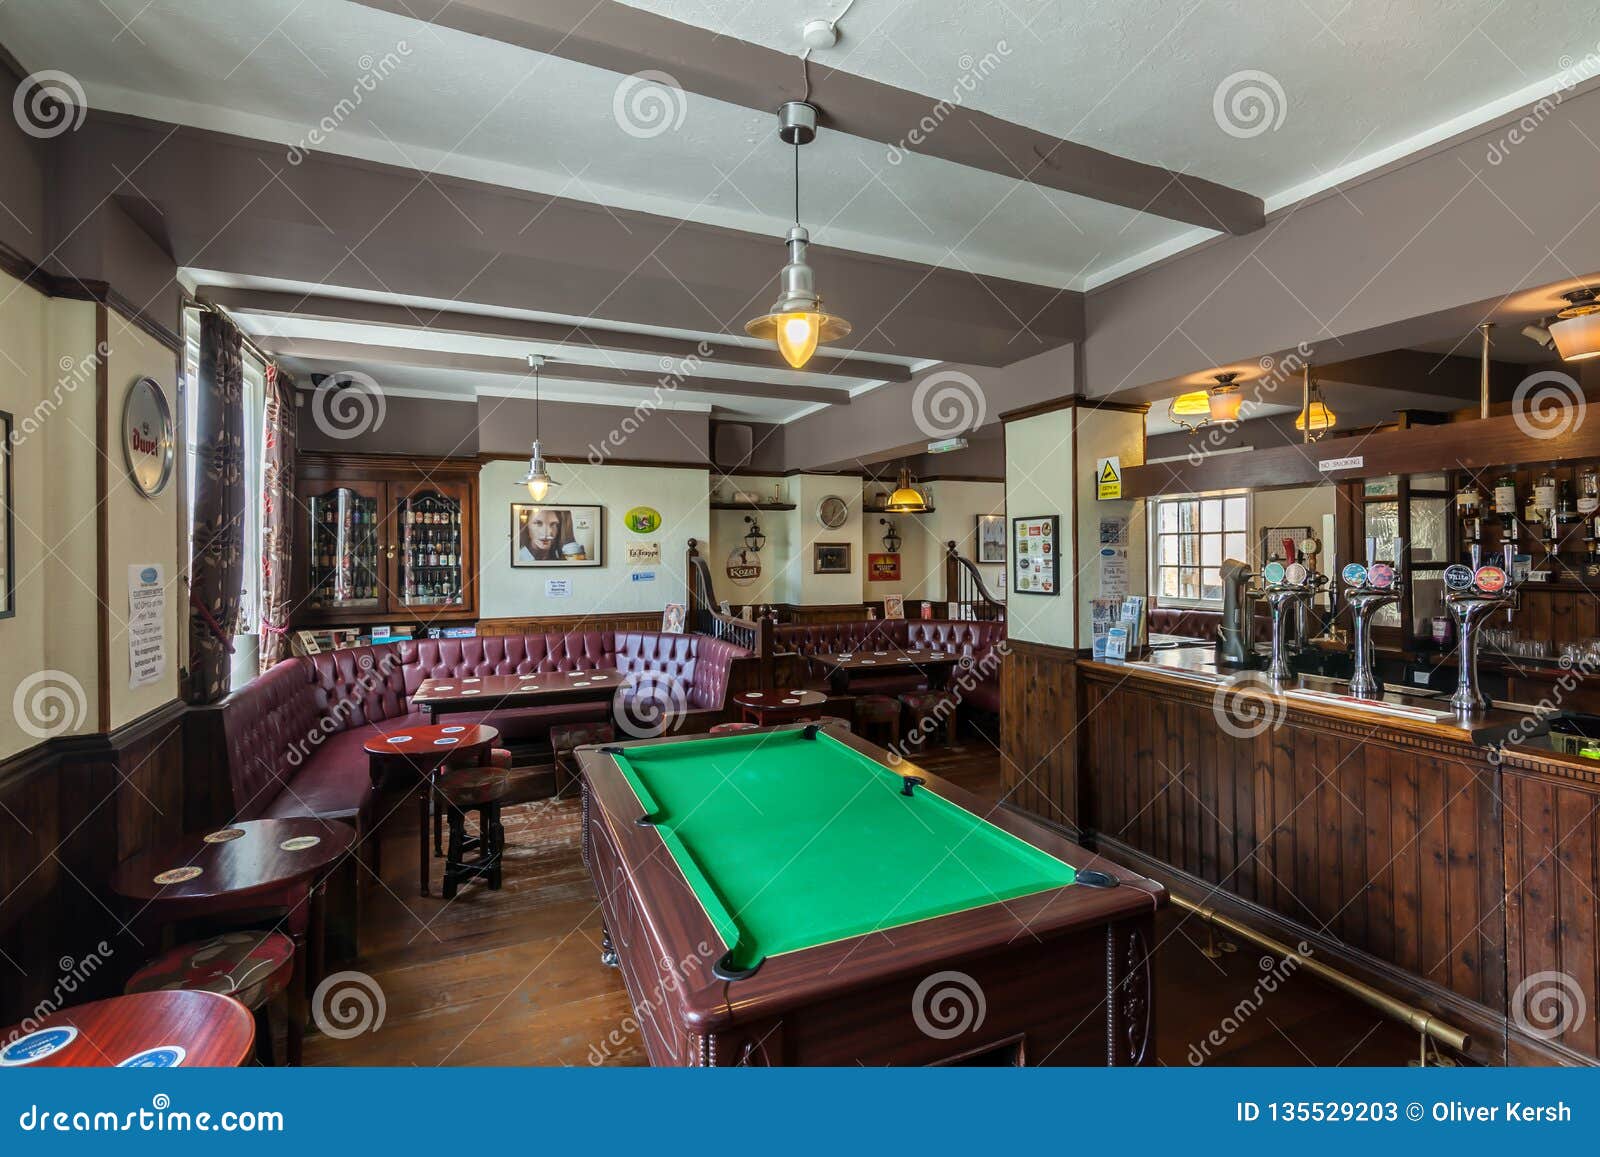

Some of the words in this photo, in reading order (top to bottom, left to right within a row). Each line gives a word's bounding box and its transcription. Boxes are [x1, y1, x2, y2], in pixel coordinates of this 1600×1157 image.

[133, 427, 158, 457] Duvel
[638, 549, 658, 557] Trappe
[730, 567, 758, 577] Kozel
